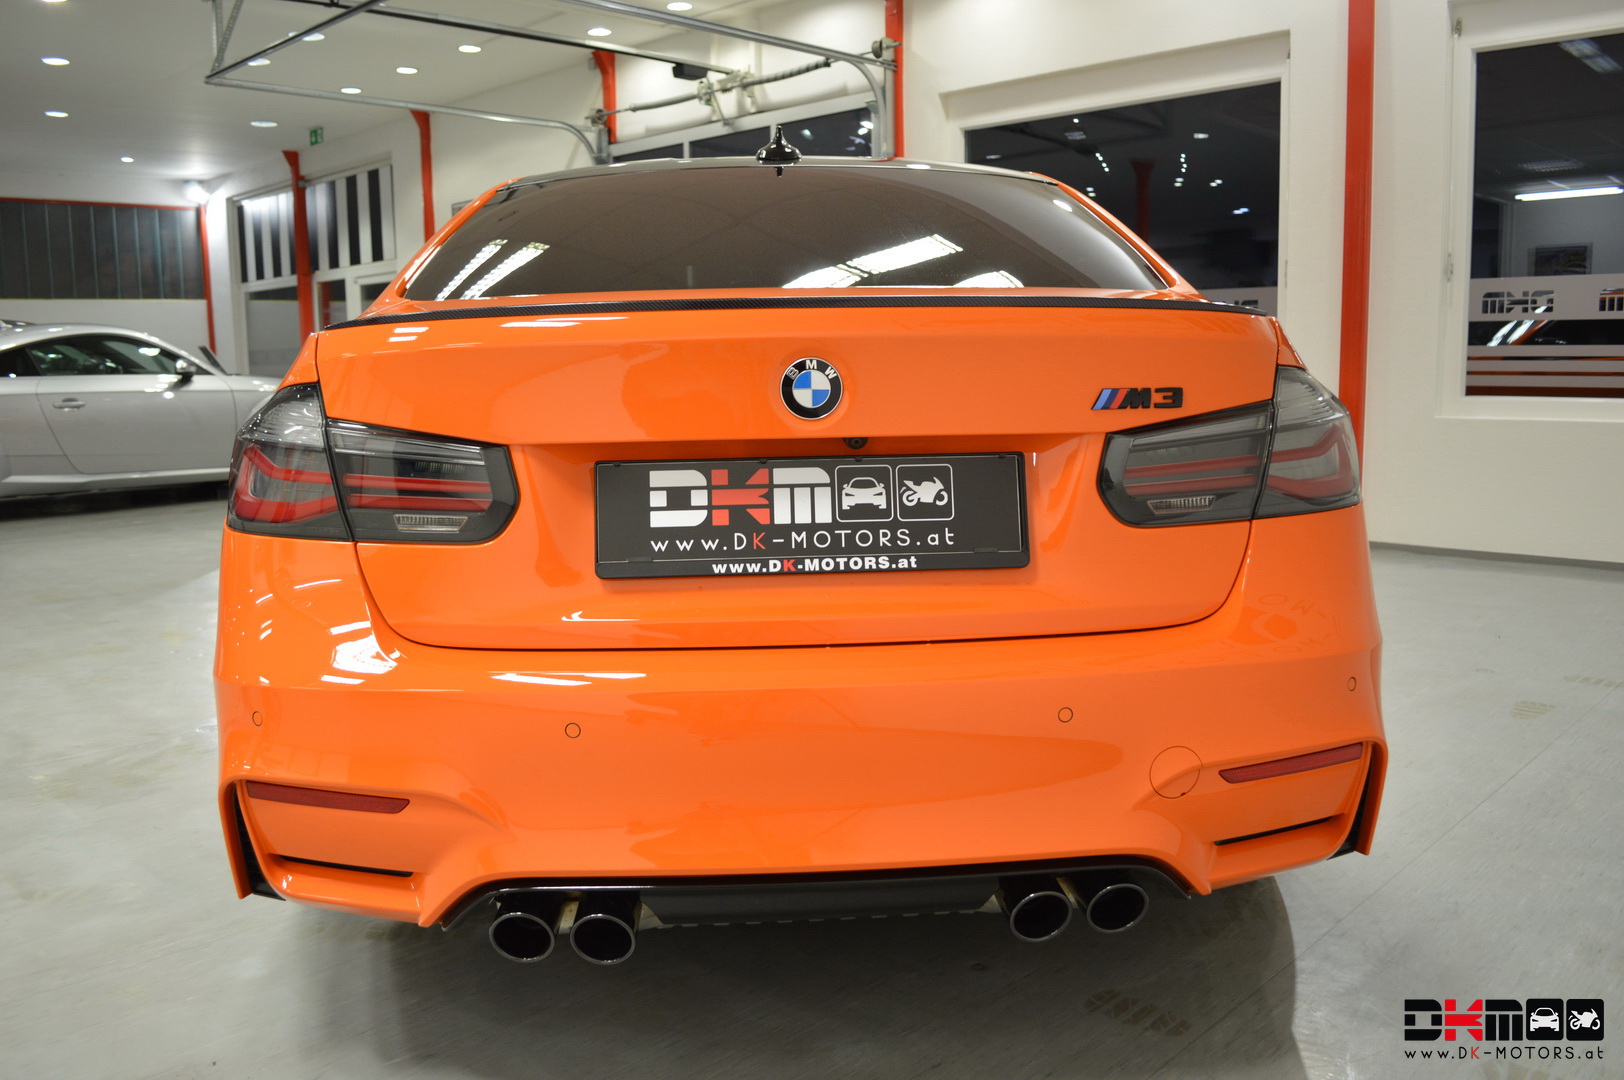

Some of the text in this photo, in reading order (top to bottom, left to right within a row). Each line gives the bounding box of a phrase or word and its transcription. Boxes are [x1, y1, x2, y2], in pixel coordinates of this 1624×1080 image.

[786, 359, 838, 380] BMW
[1116, 387, 1184, 410] M3
[649, 467, 833, 528] DKM
[650, 528, 955, 553] www.DK-MOTORS.at
[712, 555, 918, 574] www.DK-MOTORS.at
